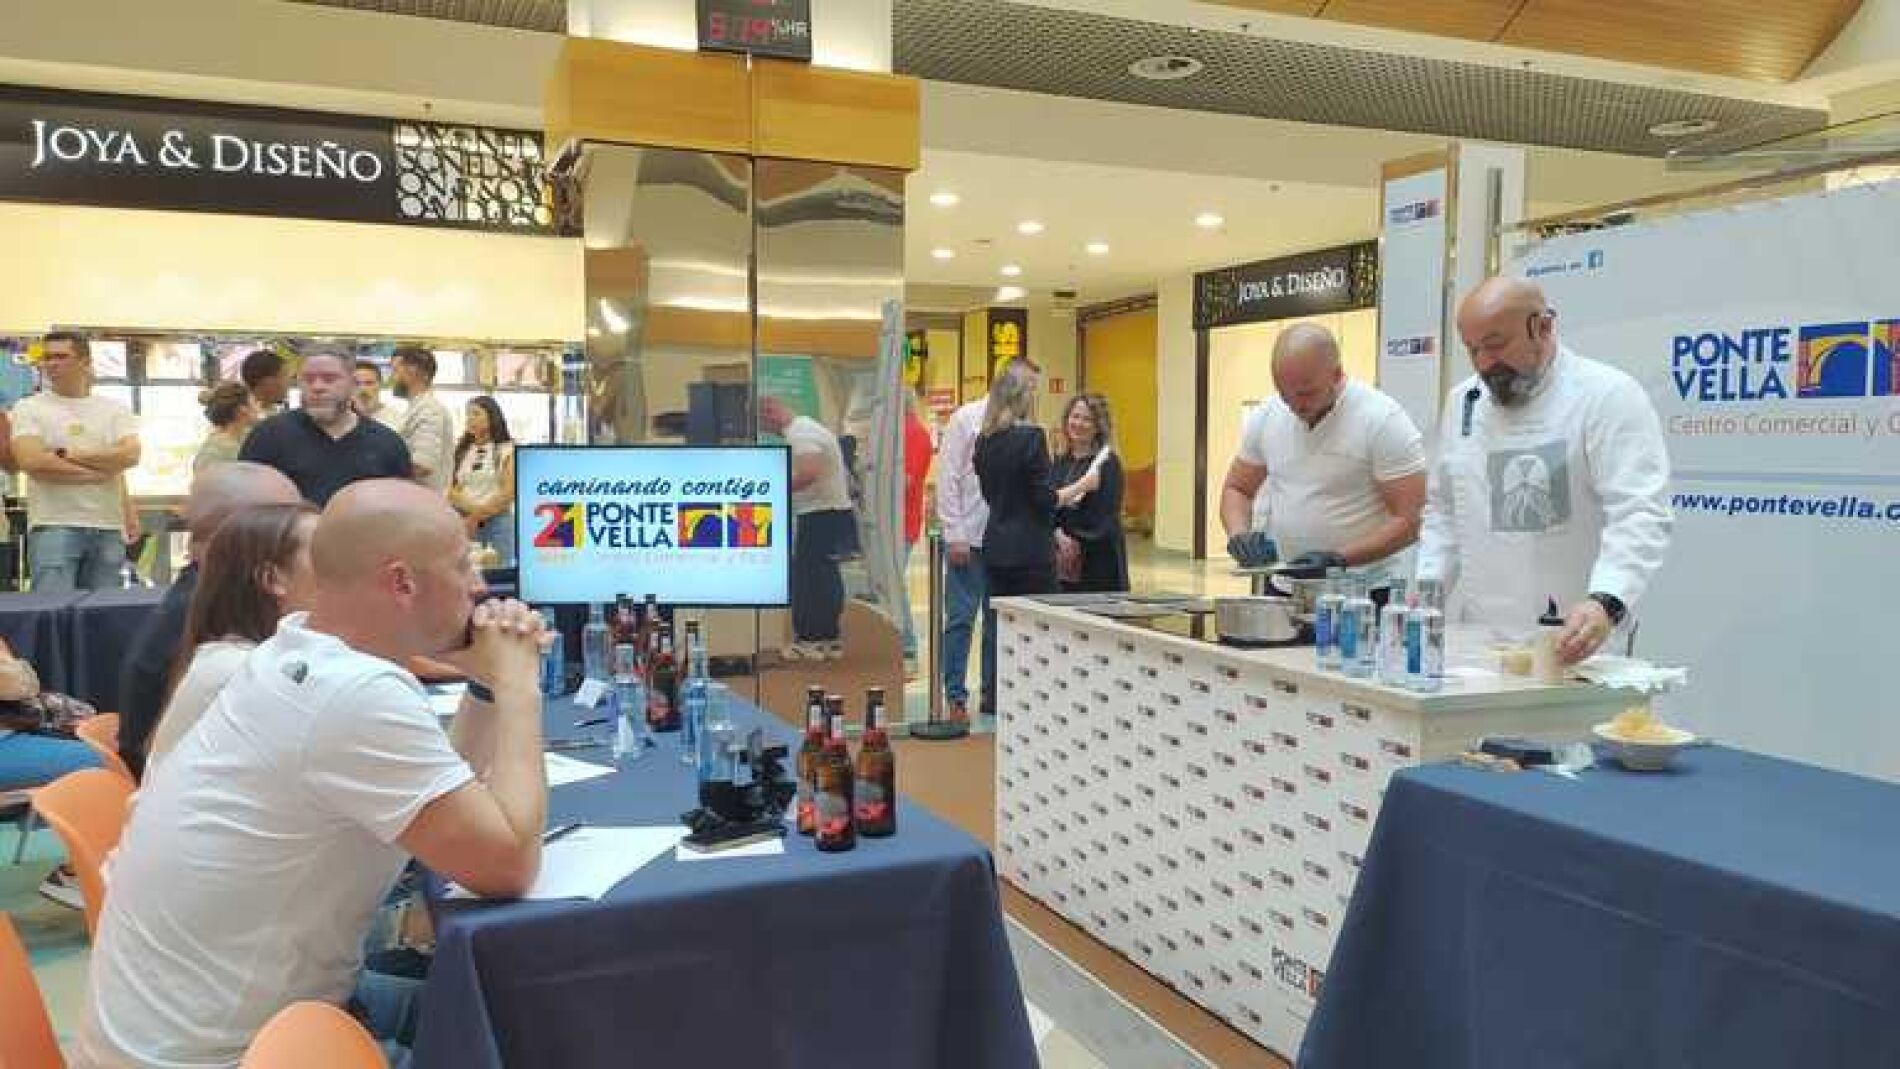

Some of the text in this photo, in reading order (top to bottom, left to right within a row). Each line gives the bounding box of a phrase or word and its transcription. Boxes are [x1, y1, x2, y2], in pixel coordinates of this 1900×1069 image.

[31, 118, 148, 169] JOYA
[159, 130, 199, 168] &
[210, 134, 382, 182] DISEÑO
[1672, 328, 1792, 367] PONTE
[1672, 366, 1787, 401] VELLA
[1669, 414, 1737, 435] Centro
[1743, 413, 1857, 435] Comercial
[1864, 417, 1879, 441] y
[536, 475, 771, 500] caminando contigo
[586, 502, 674, 525] PONTE
[587, 526, 674, 548] VELLA
